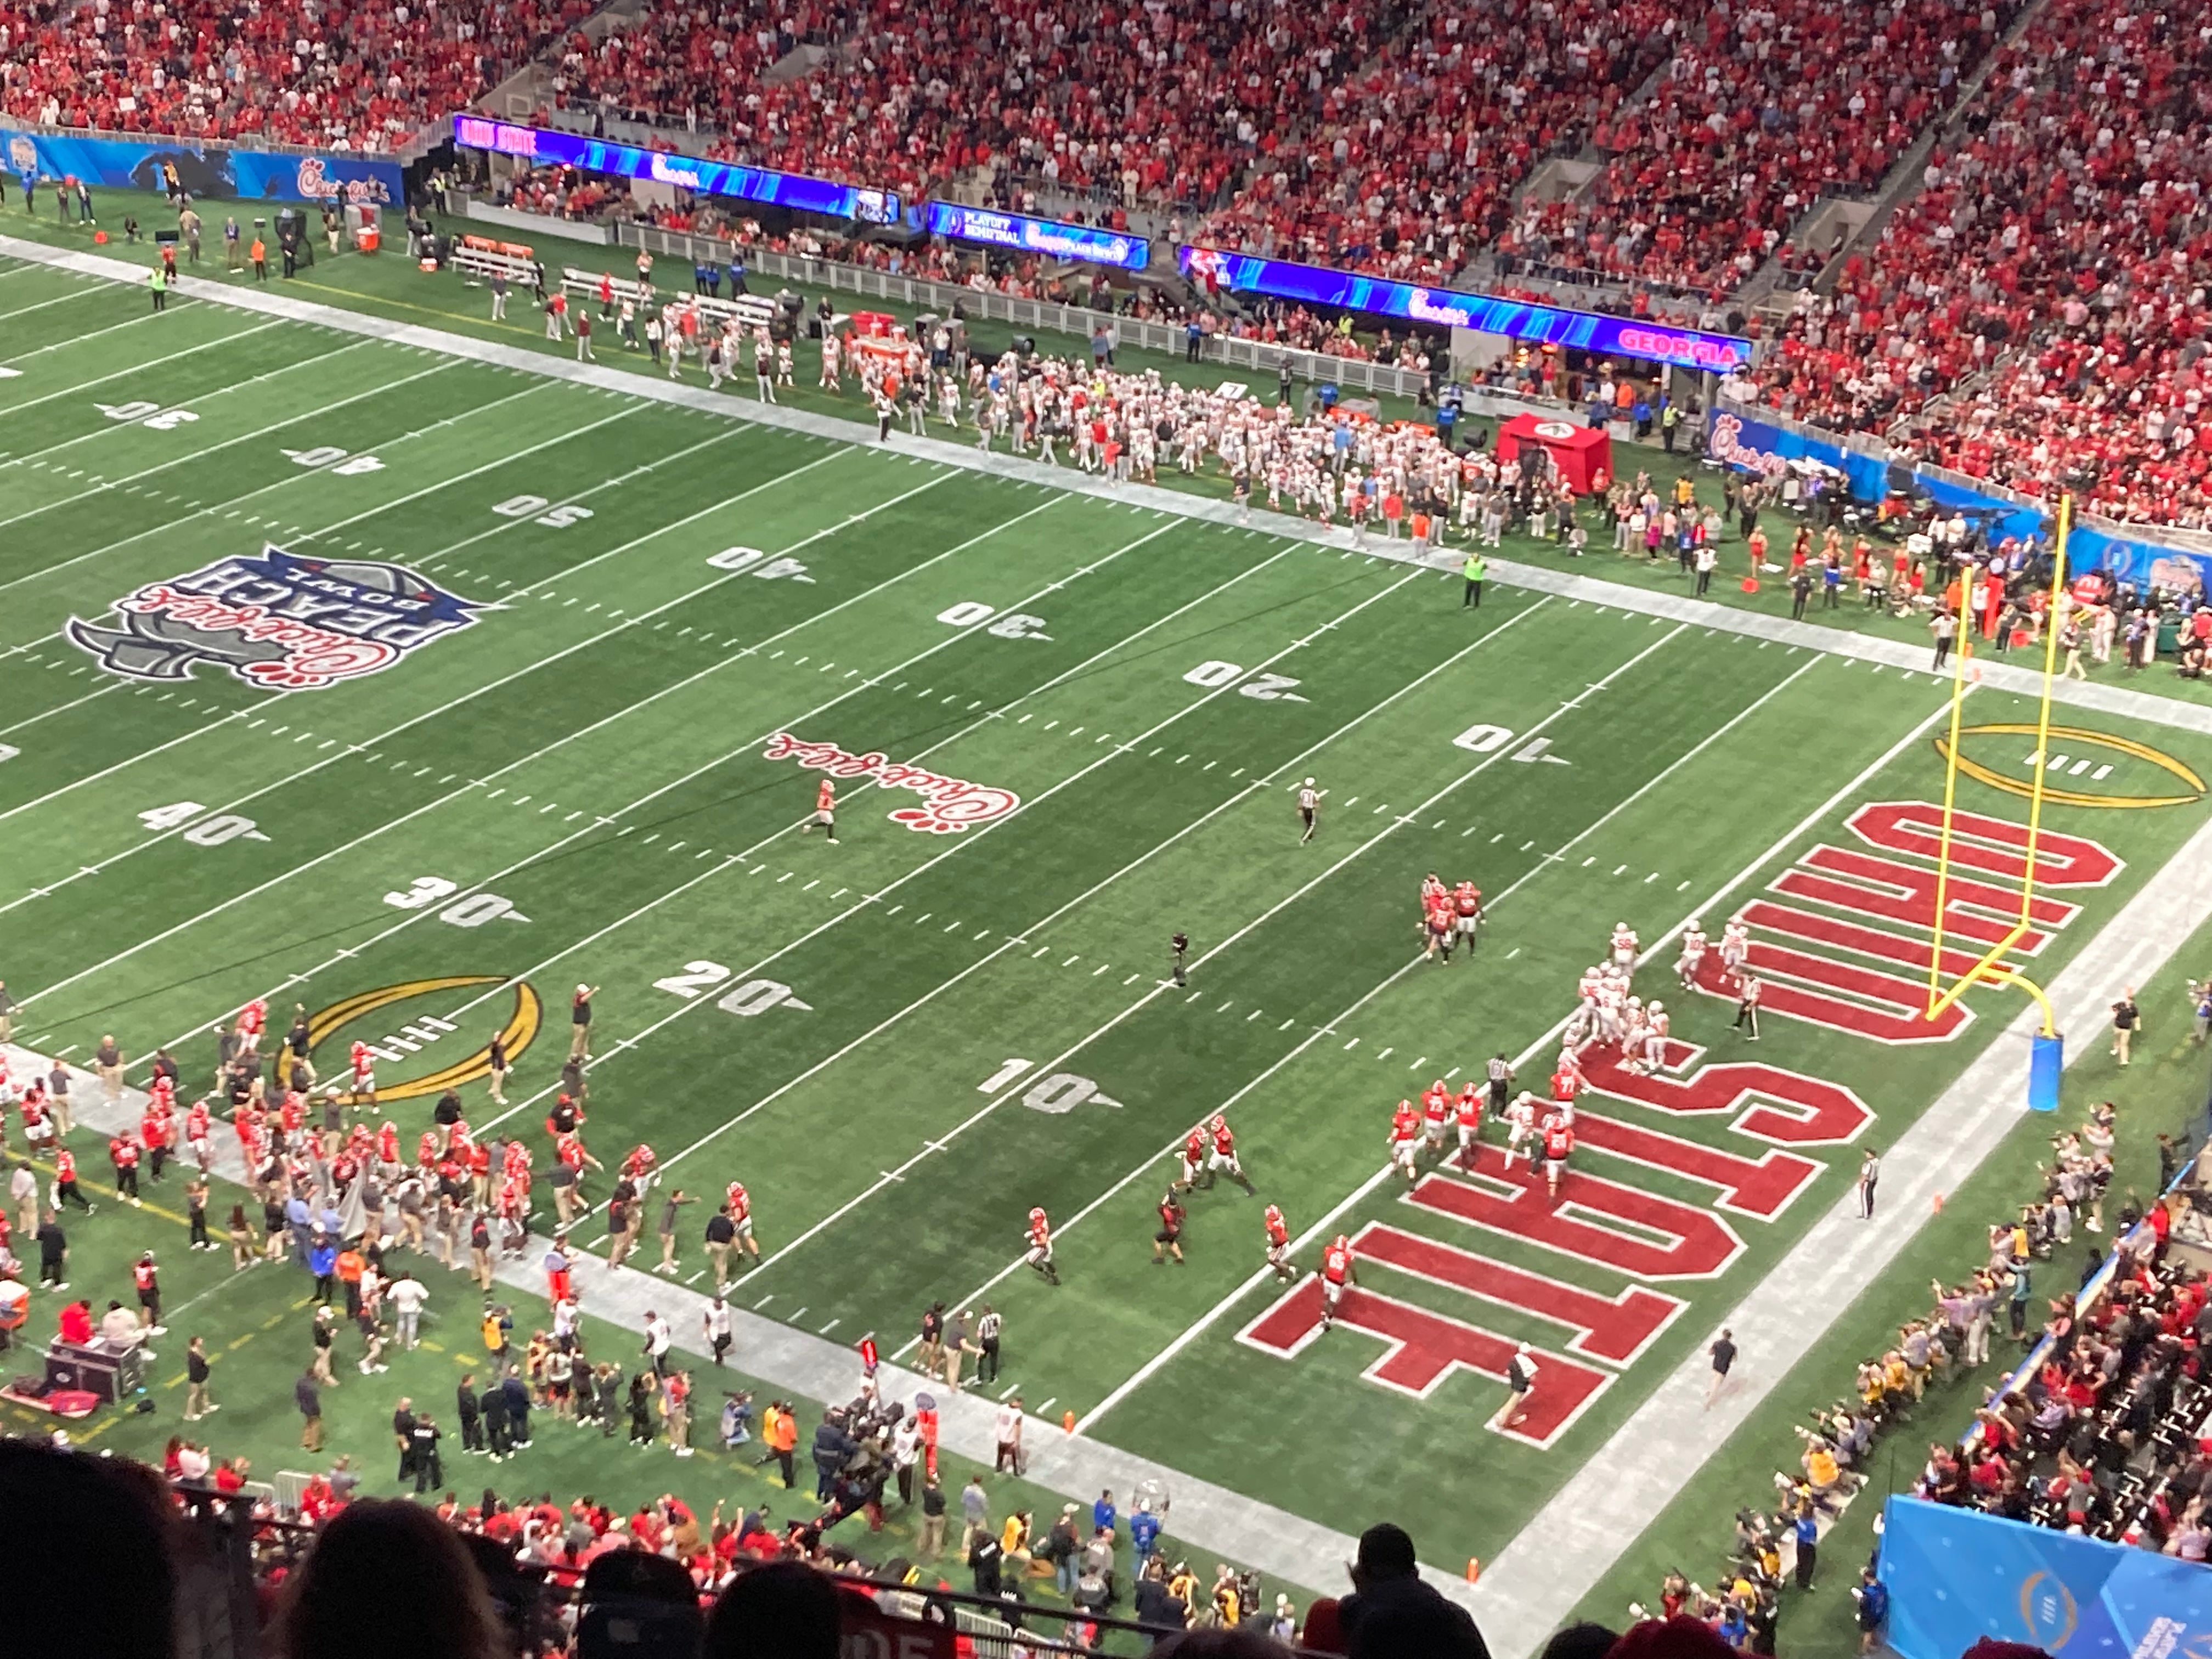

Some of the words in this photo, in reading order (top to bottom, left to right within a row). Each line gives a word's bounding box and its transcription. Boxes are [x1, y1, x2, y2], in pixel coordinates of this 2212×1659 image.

[1619, 329, 1737, 366] GEORGIA
[104, 401, 200, 429] 30
[291, 446, 387, 475] 40
[492, 494, 594, 528] 50
[706, 546, 808, 579] 40
[174, 562, 462, 648] PEACH
[285, 567, 430, 611] BOWL
[127, 585, 397, 681] Chick-fil-A
[936, 602, 1046, 639] 30
[1183, 661, 1302, 700] 20
[1452, 724, 1554, 763] 10
[764, 733, 1020, 830] Chick-fil-A
[137, 801, 257, 845] 40
[383, 876, 514, 927] 30
[1673, 801, 2127, 1046] OHIO
[652, 960, 793, 1016] 20
[977, 1058, 1099, 1114] 10
[1235, 1036, 1877, 1450] STATE
